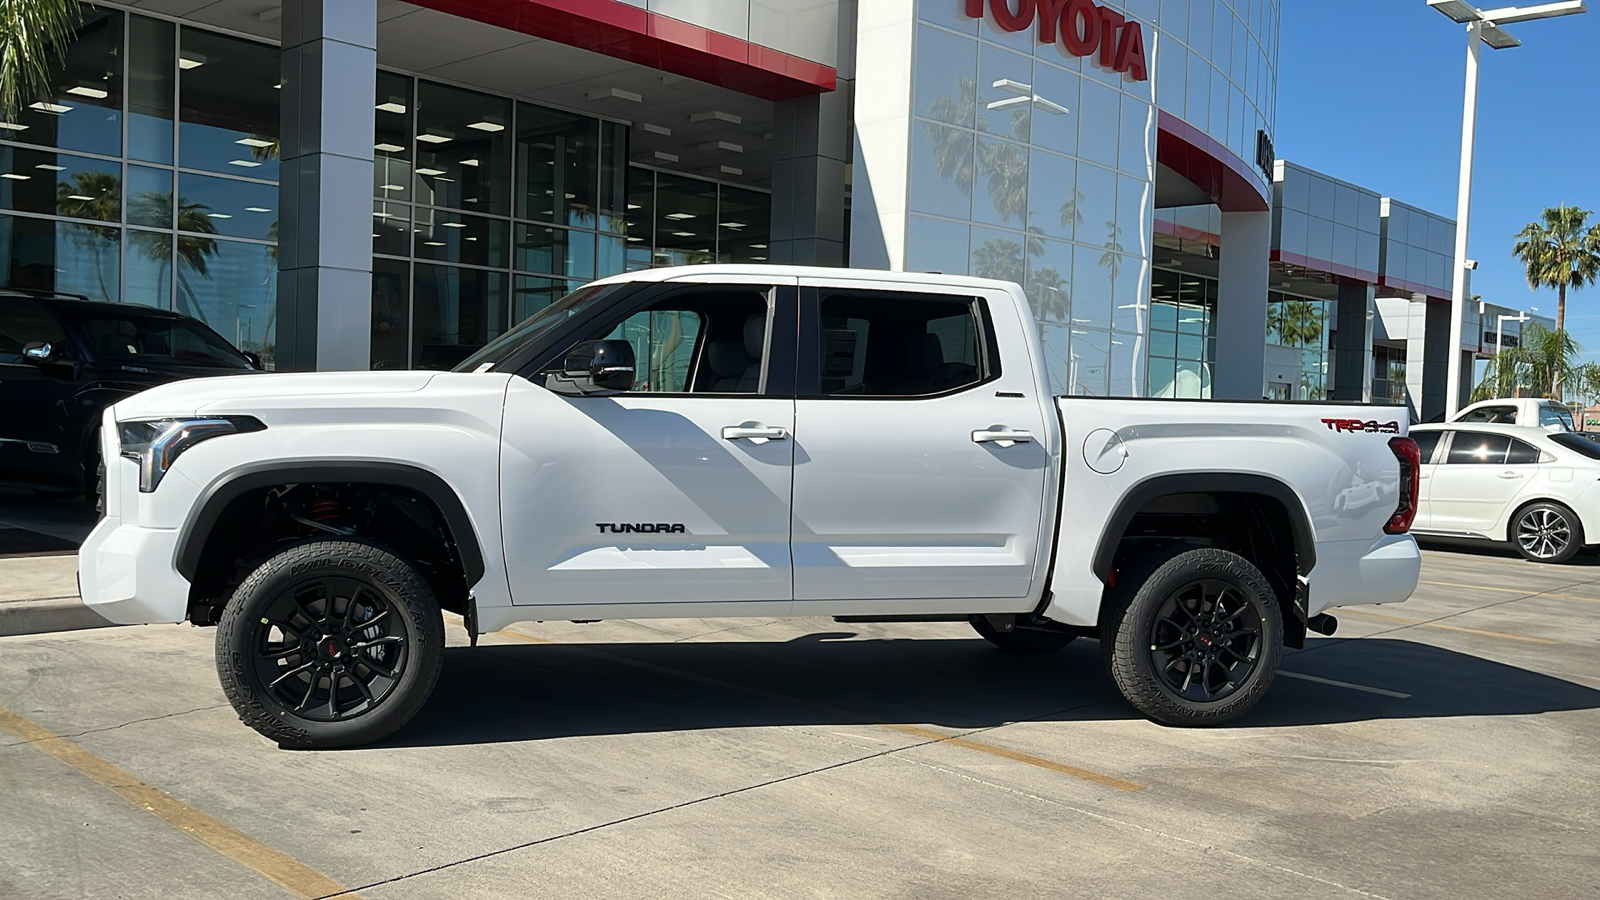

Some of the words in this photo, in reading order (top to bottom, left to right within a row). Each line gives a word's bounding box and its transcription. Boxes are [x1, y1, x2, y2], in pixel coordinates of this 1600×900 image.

[1320, 418, 1364, 433] TRD
[595, 523, 685, 533] TUNDRA
[289, 558, 413, 606] WILDPEAK
